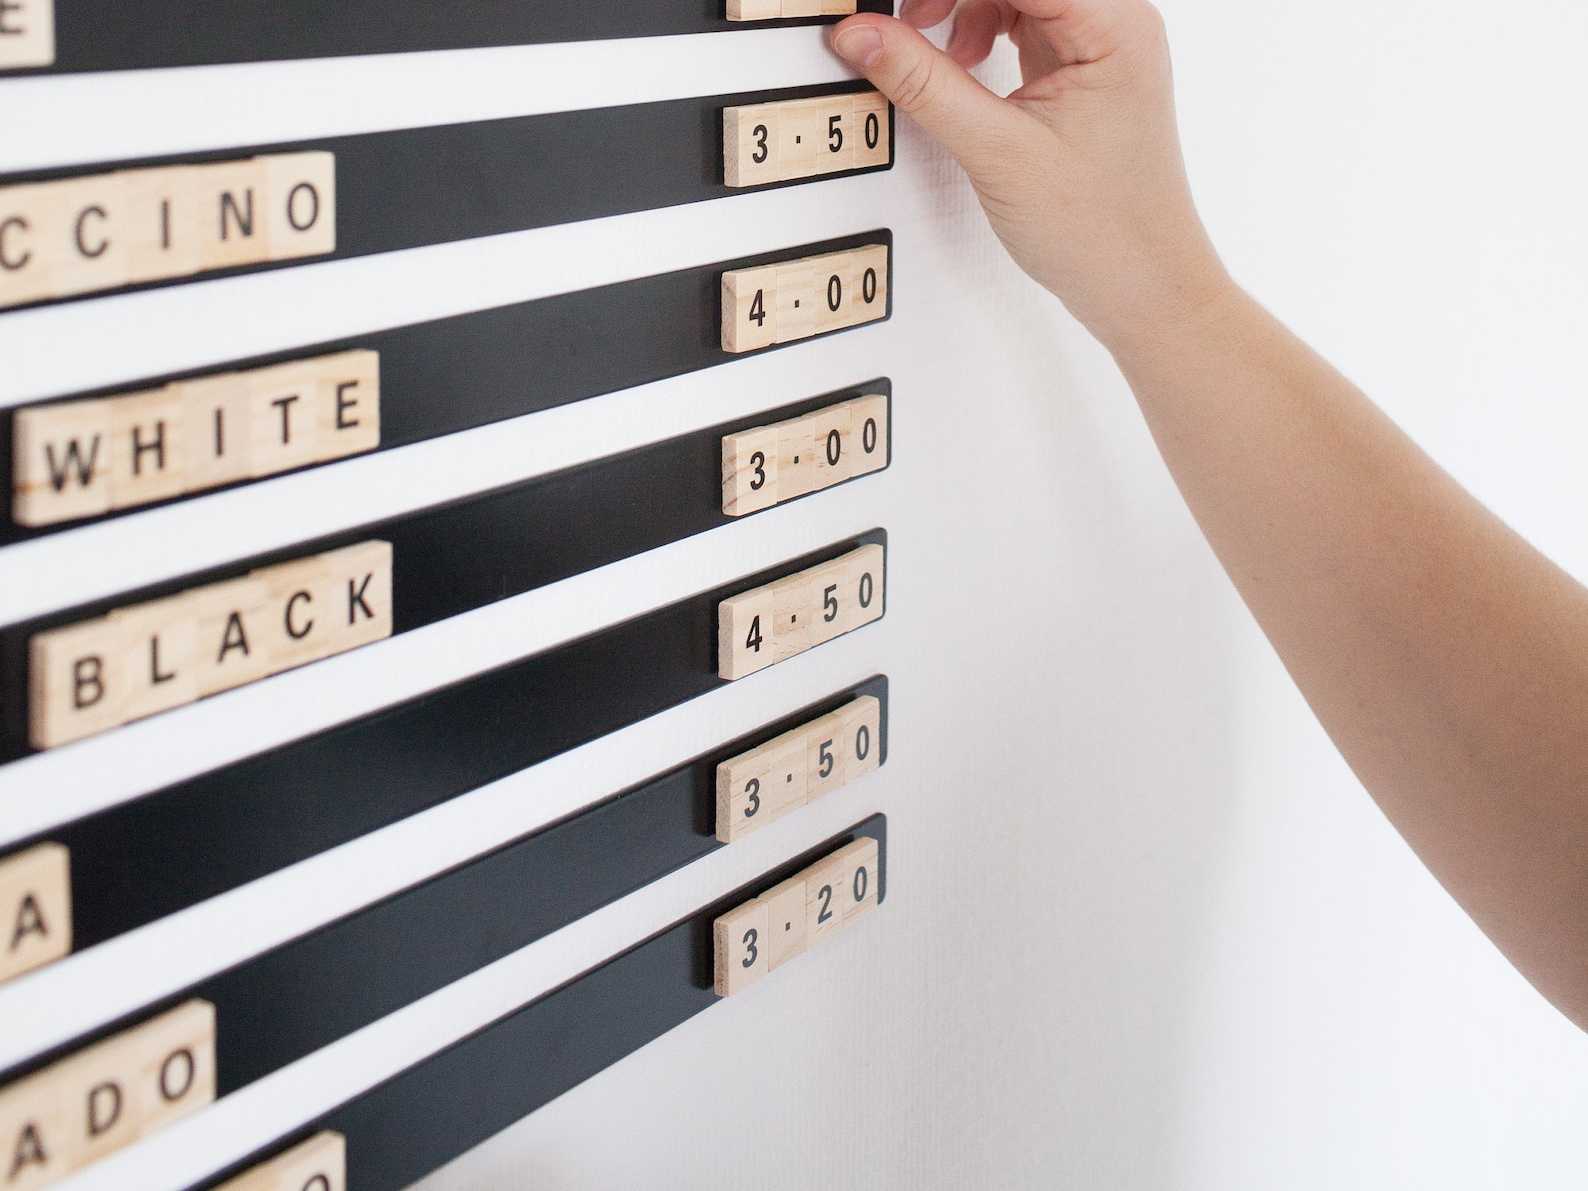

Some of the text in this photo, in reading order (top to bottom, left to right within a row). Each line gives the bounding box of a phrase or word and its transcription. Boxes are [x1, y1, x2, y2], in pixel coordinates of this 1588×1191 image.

[0, 182, 321, 271] CCINO
[46, 380, 360, 493] WHITE
[73, 572, 375, 710] BLACK
[9, 892, 49, 954] A
[6, 1047, 196, 1183] ADO
